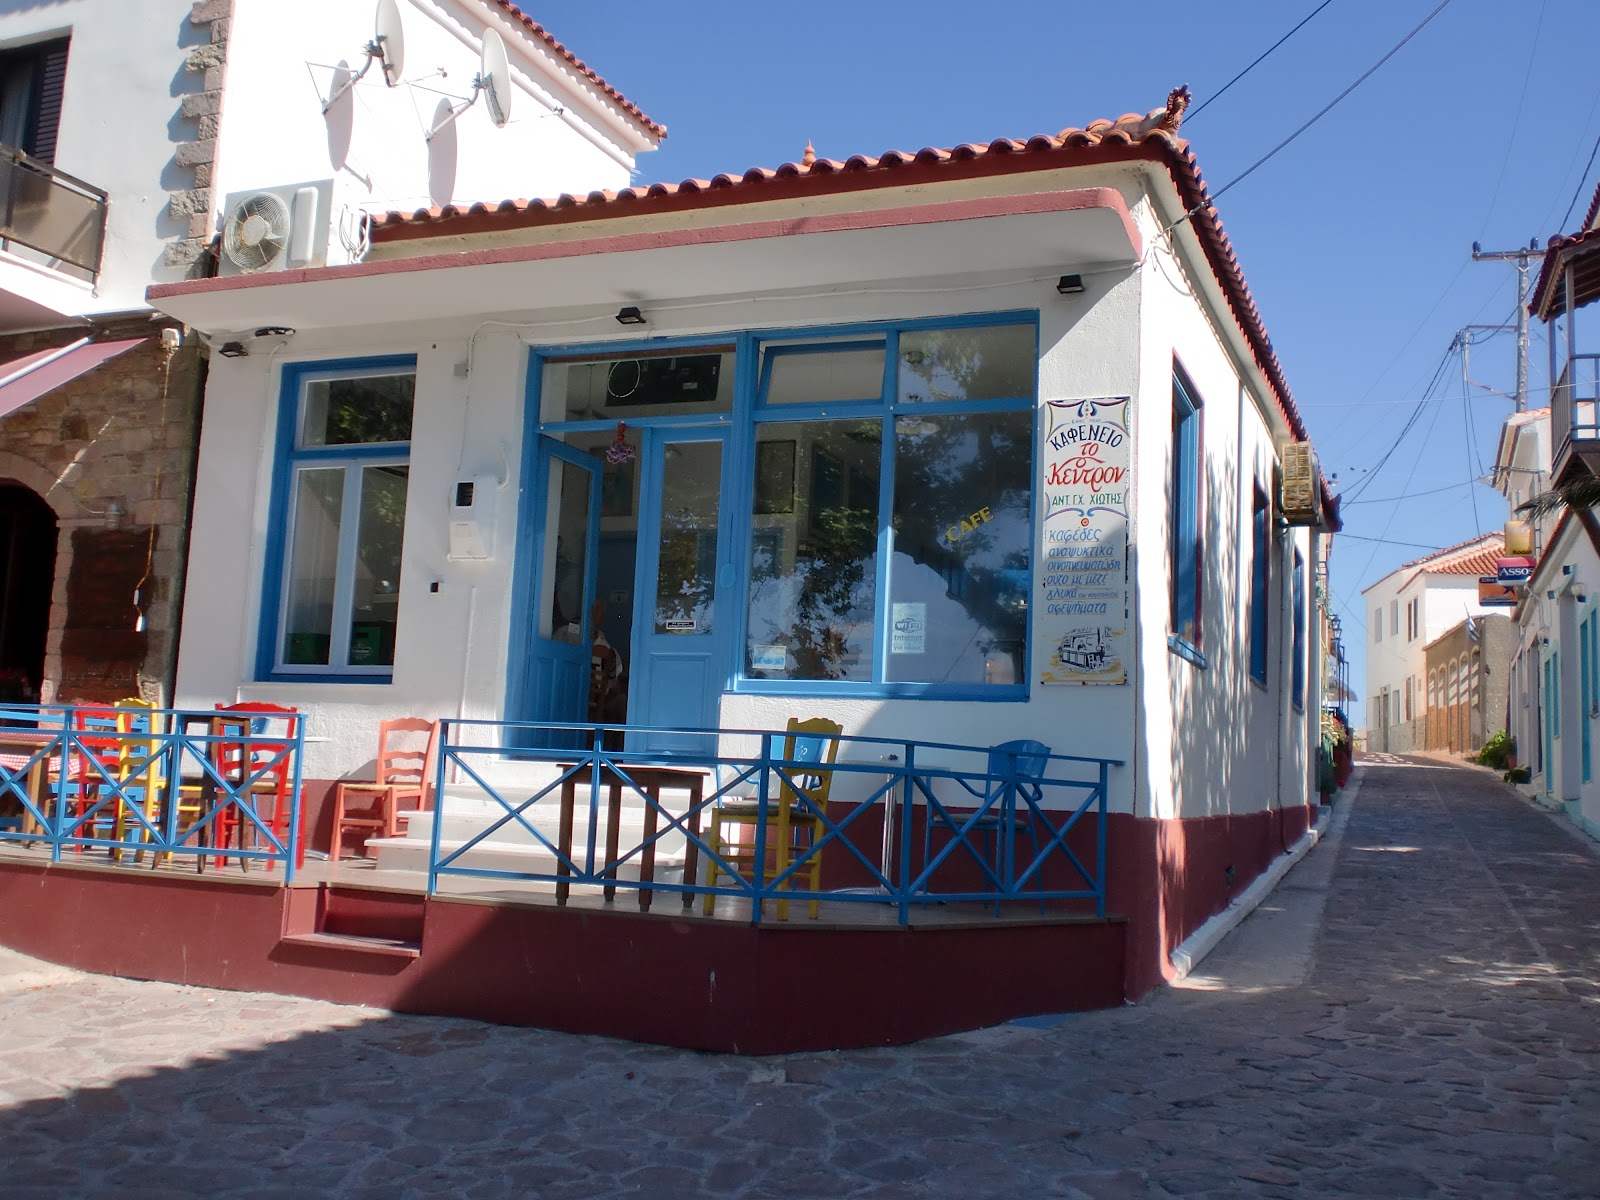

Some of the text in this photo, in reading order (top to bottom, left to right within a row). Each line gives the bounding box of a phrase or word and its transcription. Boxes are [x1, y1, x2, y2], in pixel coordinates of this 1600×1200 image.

[1050, 424, 1123, 452] ΚΑΦΕΝΕΙΟ
[1089, 493, 1123, 505] ΧΙΩΤΗΣ
[947, 506, 994, 541] CAFE
[1049, 527, 1102, 543] καφέδες
[1048, 544, 1114, 557] αναψυκτικά
